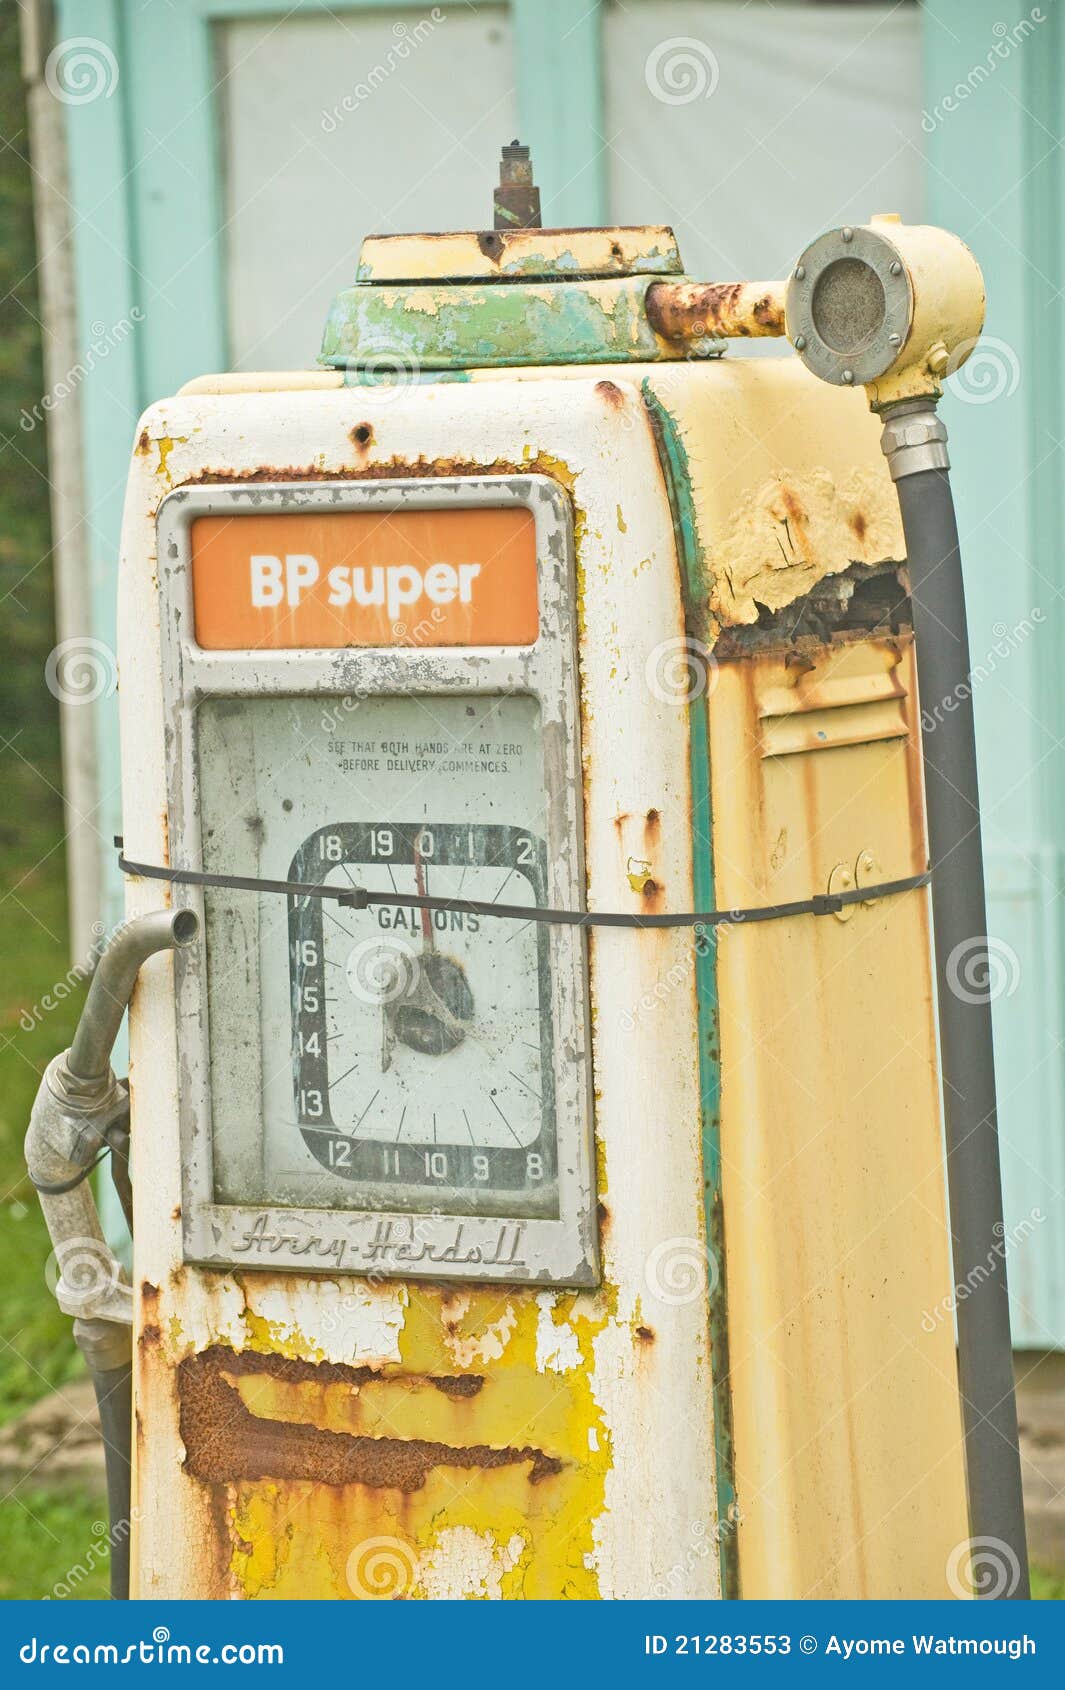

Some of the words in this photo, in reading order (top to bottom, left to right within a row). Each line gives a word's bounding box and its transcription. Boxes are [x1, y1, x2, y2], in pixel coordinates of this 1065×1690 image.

[250, 554, 320, 607] BP
[327, 563, 481, 620] super
[327, 741, 345, 753] SEE
[352, 741, 375, 753] THAT
[381, 742, 409, 753] BOTH
[415, 742, 449, 754] HANDS
[479, 743, 491, 755] AT
[496, 743, 522, 755] ZERO
[342, 759, 380, 771] BEFORE
[386, 759, 435, 771] DELIVERY
[319, 835, 342, 861] 18
[370, 830, 394, 856] 19
[419, 831, 434, 857] 0
[516, 838, 536, 865] 2
[377, 907, 481, 933] GALONS
[296, 940, 319, 967] 16
[299, 1031, 322, 1058] 14
[300, 1090, 324, 1117] 13
[328, 1141, 352, 1168] 12
[383, 1150, 400, 1176] 11
[425, 1152, 448, 1178] 10
[473, 1156, 490, 1181] 9
[526, 1153, 544, 1180] 8
